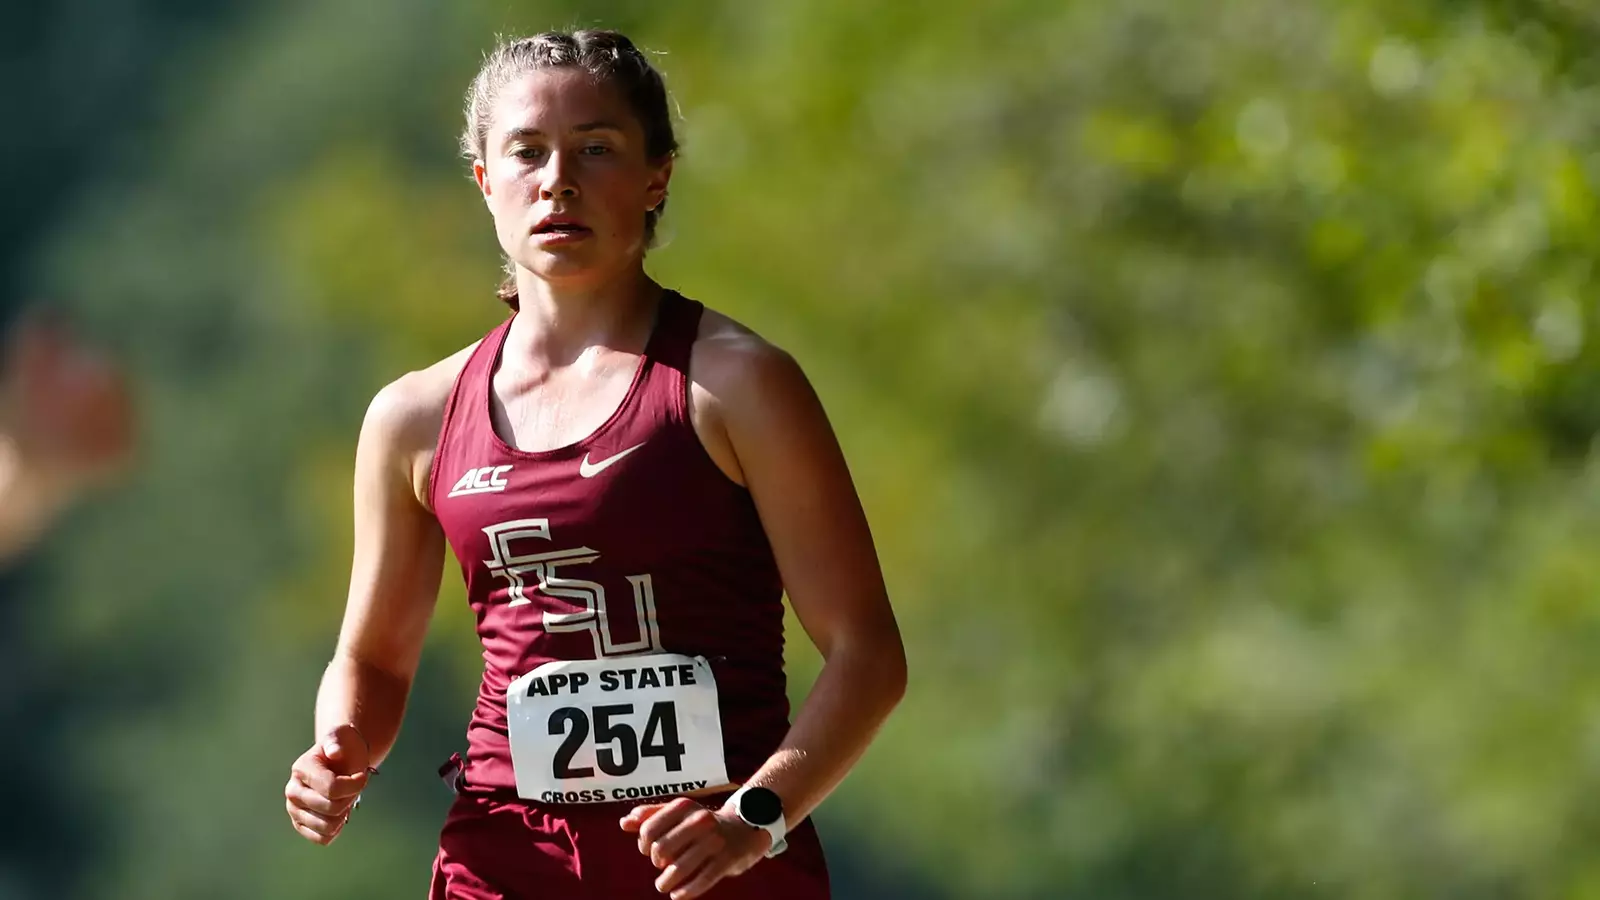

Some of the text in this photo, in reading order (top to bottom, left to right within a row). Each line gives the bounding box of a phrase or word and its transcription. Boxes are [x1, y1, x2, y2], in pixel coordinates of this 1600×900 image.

[449, 464, 513, 492] ACC
[481, 518, 664, 660] FSU
[526, 664, 697, 697] APP STATE
[547, 700, 686, 780] 254
[541, 780, 708, 804] CROSS COUNTRY
